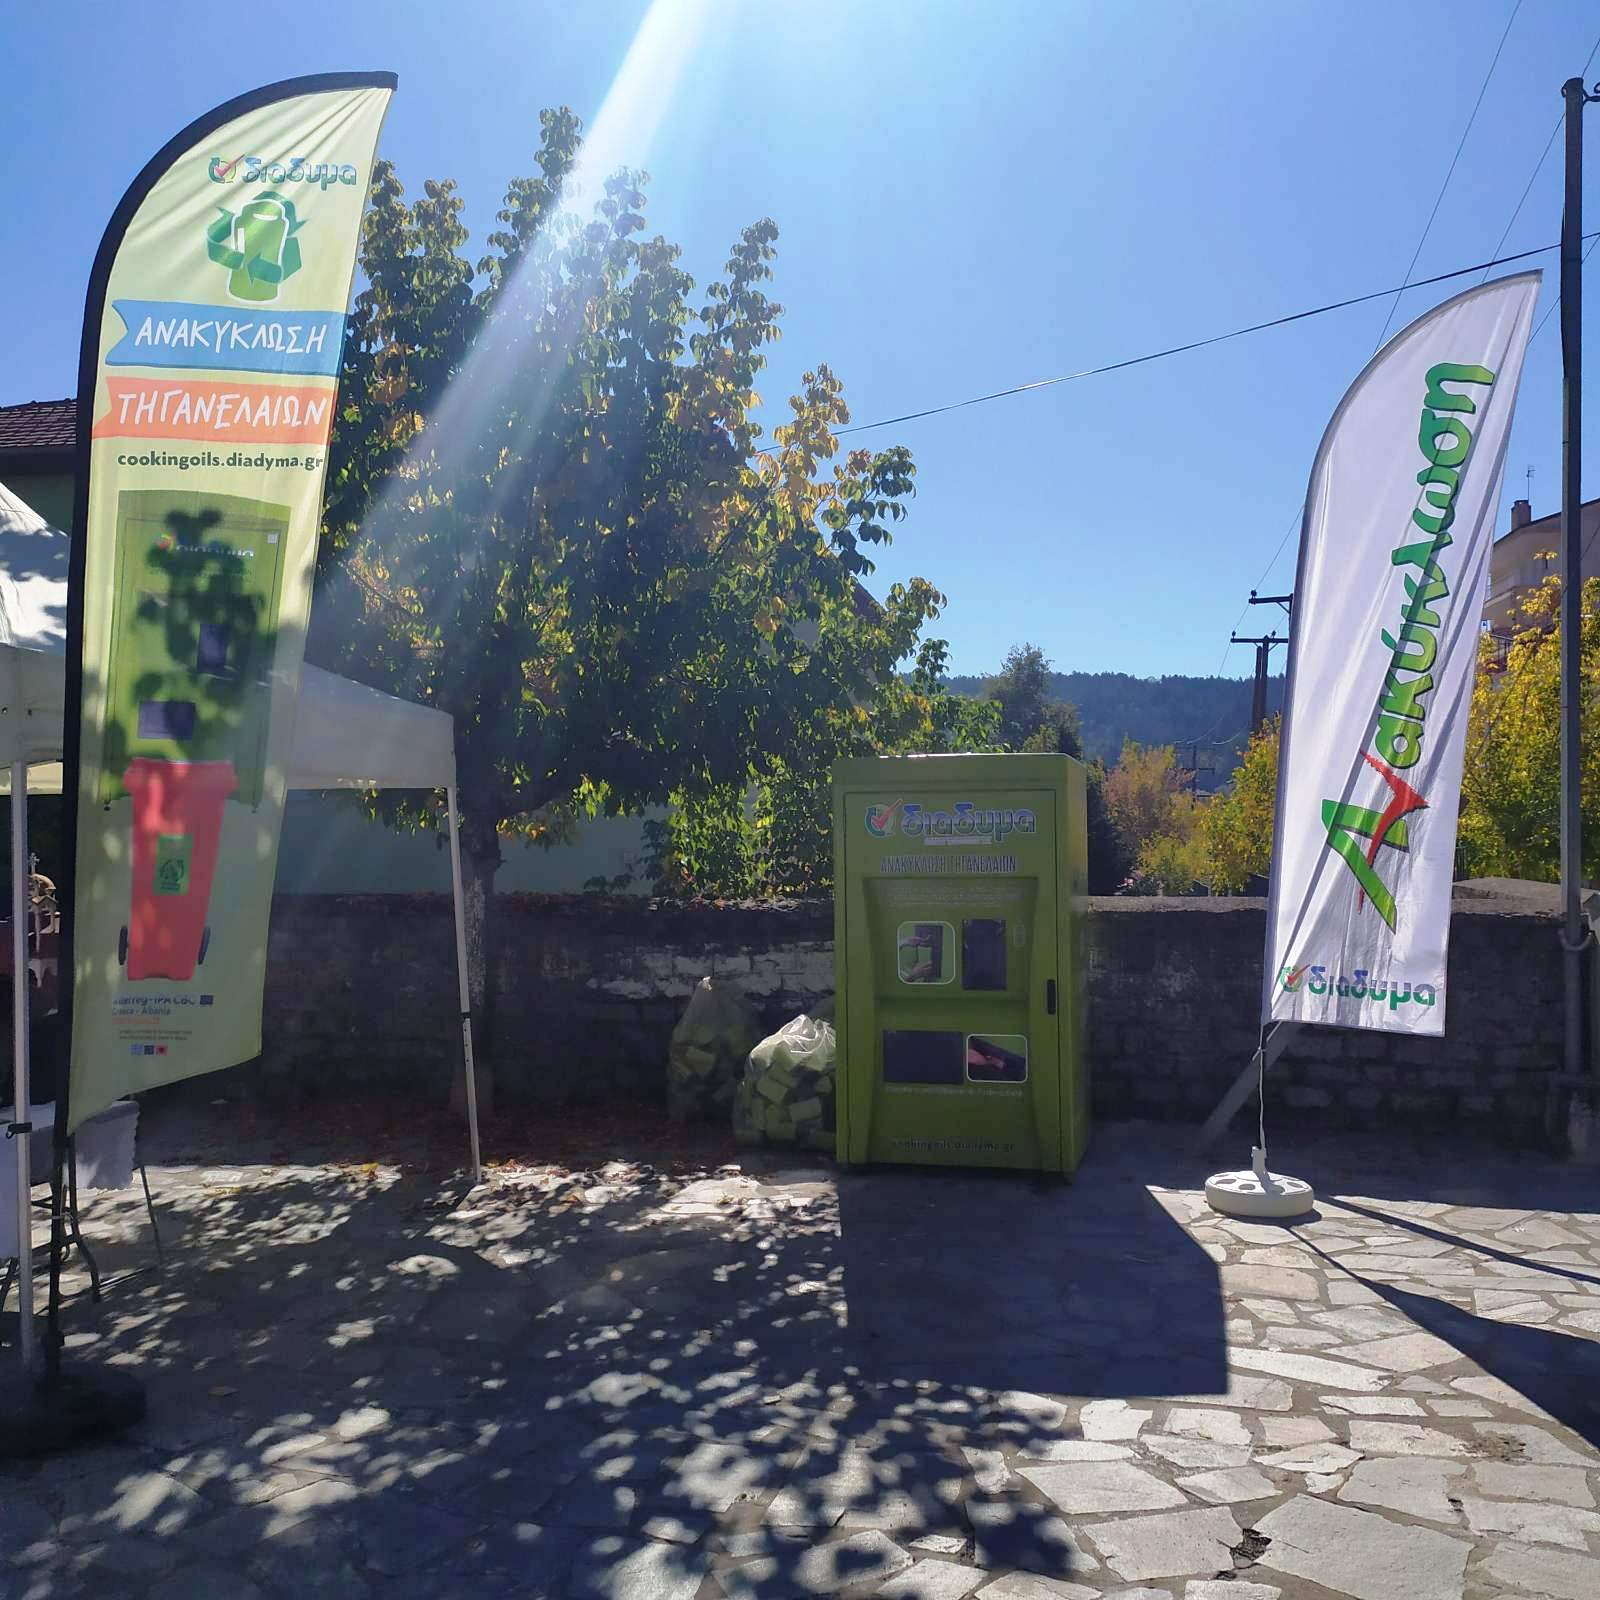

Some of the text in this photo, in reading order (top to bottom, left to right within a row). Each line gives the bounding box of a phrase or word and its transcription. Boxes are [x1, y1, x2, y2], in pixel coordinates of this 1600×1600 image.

[241, 157, 357, 191] διαδυμα
[135, 316, 327, 354] ΑΝΑΚΥΚΛΩΣΗ
[118, 389, 328, 429] ΤΗΓΑΝΕΛΑΙΩΝ
[117, 450, 324, 472] cookingoils.diadyma.gr
[900, 801, 1036, 843] διαδυμα
[1308, 965, 1436, 1011] διαδυμα
